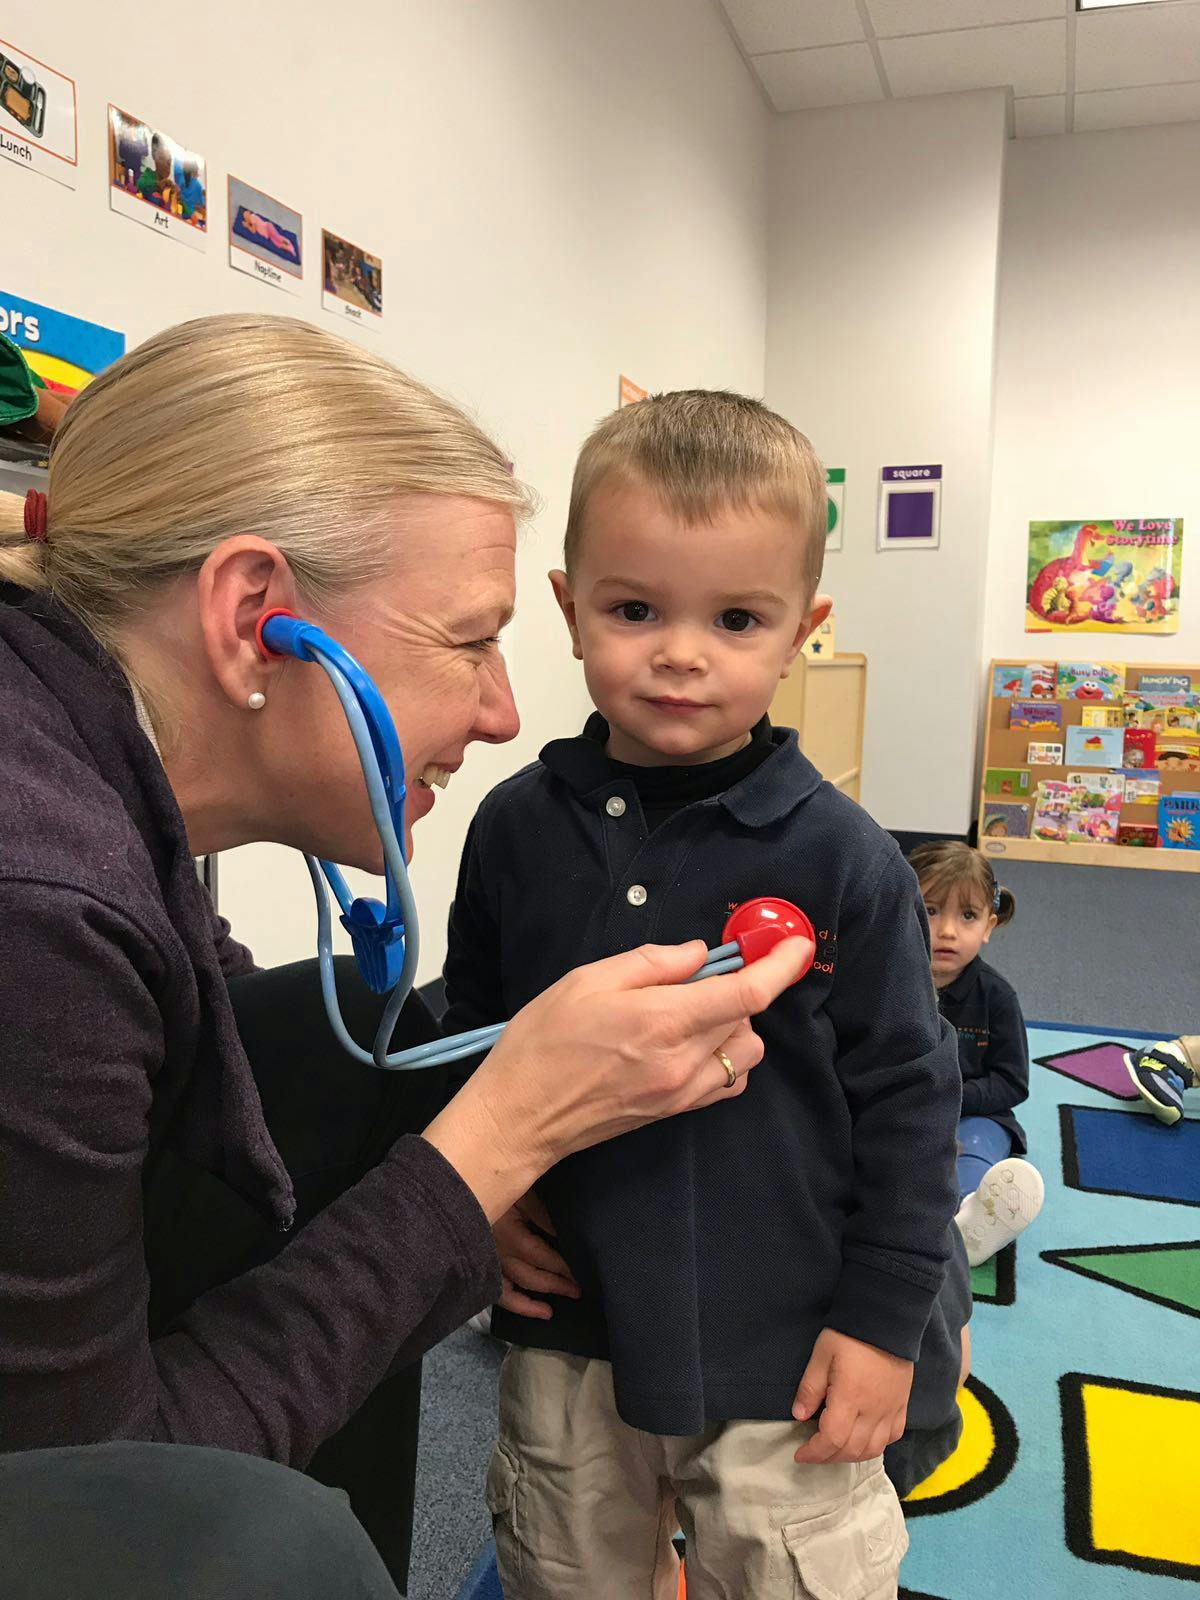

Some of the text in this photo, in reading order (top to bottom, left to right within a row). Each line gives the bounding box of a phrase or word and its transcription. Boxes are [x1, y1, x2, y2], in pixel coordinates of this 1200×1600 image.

[0, 133, 32, 161] Lunch
[154, 211, 169, 229] Art
[255, 259, 282, 282] Naptime
[892, 468, 931, 480] square
[1112, 519, 1172, 532] We Love
[1106, 535, 1178, 547] Storytime
